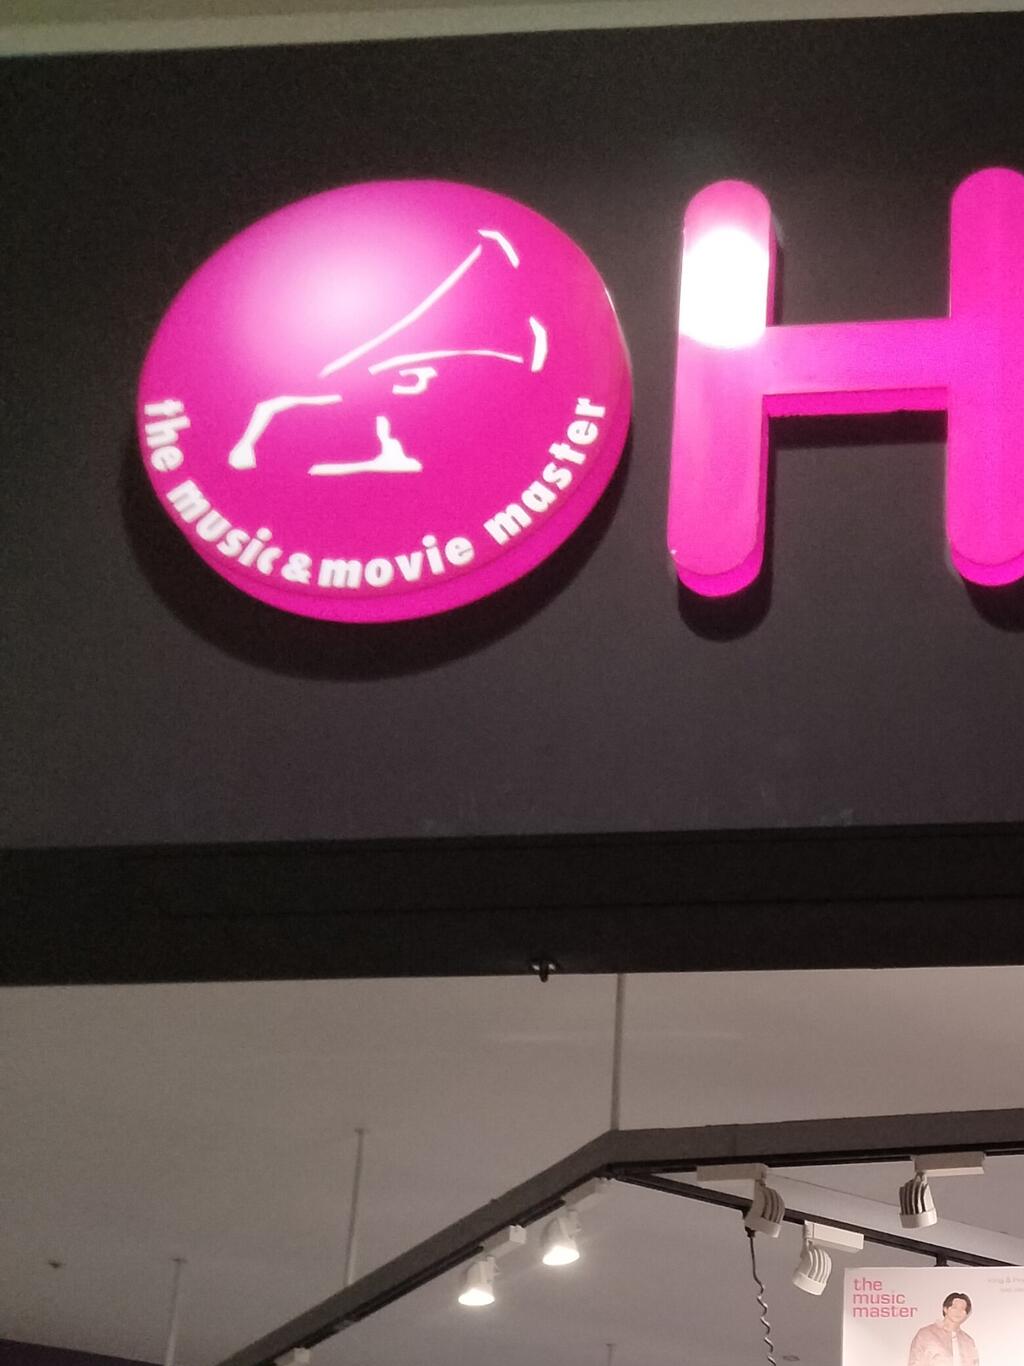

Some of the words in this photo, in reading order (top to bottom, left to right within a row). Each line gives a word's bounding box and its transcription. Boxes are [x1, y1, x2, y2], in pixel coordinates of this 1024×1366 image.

[144, 398, 191, 472] the
[482, 396, 606, 544] master
[854, 1277, 882, 1290] the
[853, 1291, 906, 1304] music
[853, 1304, 918, 1318] master
